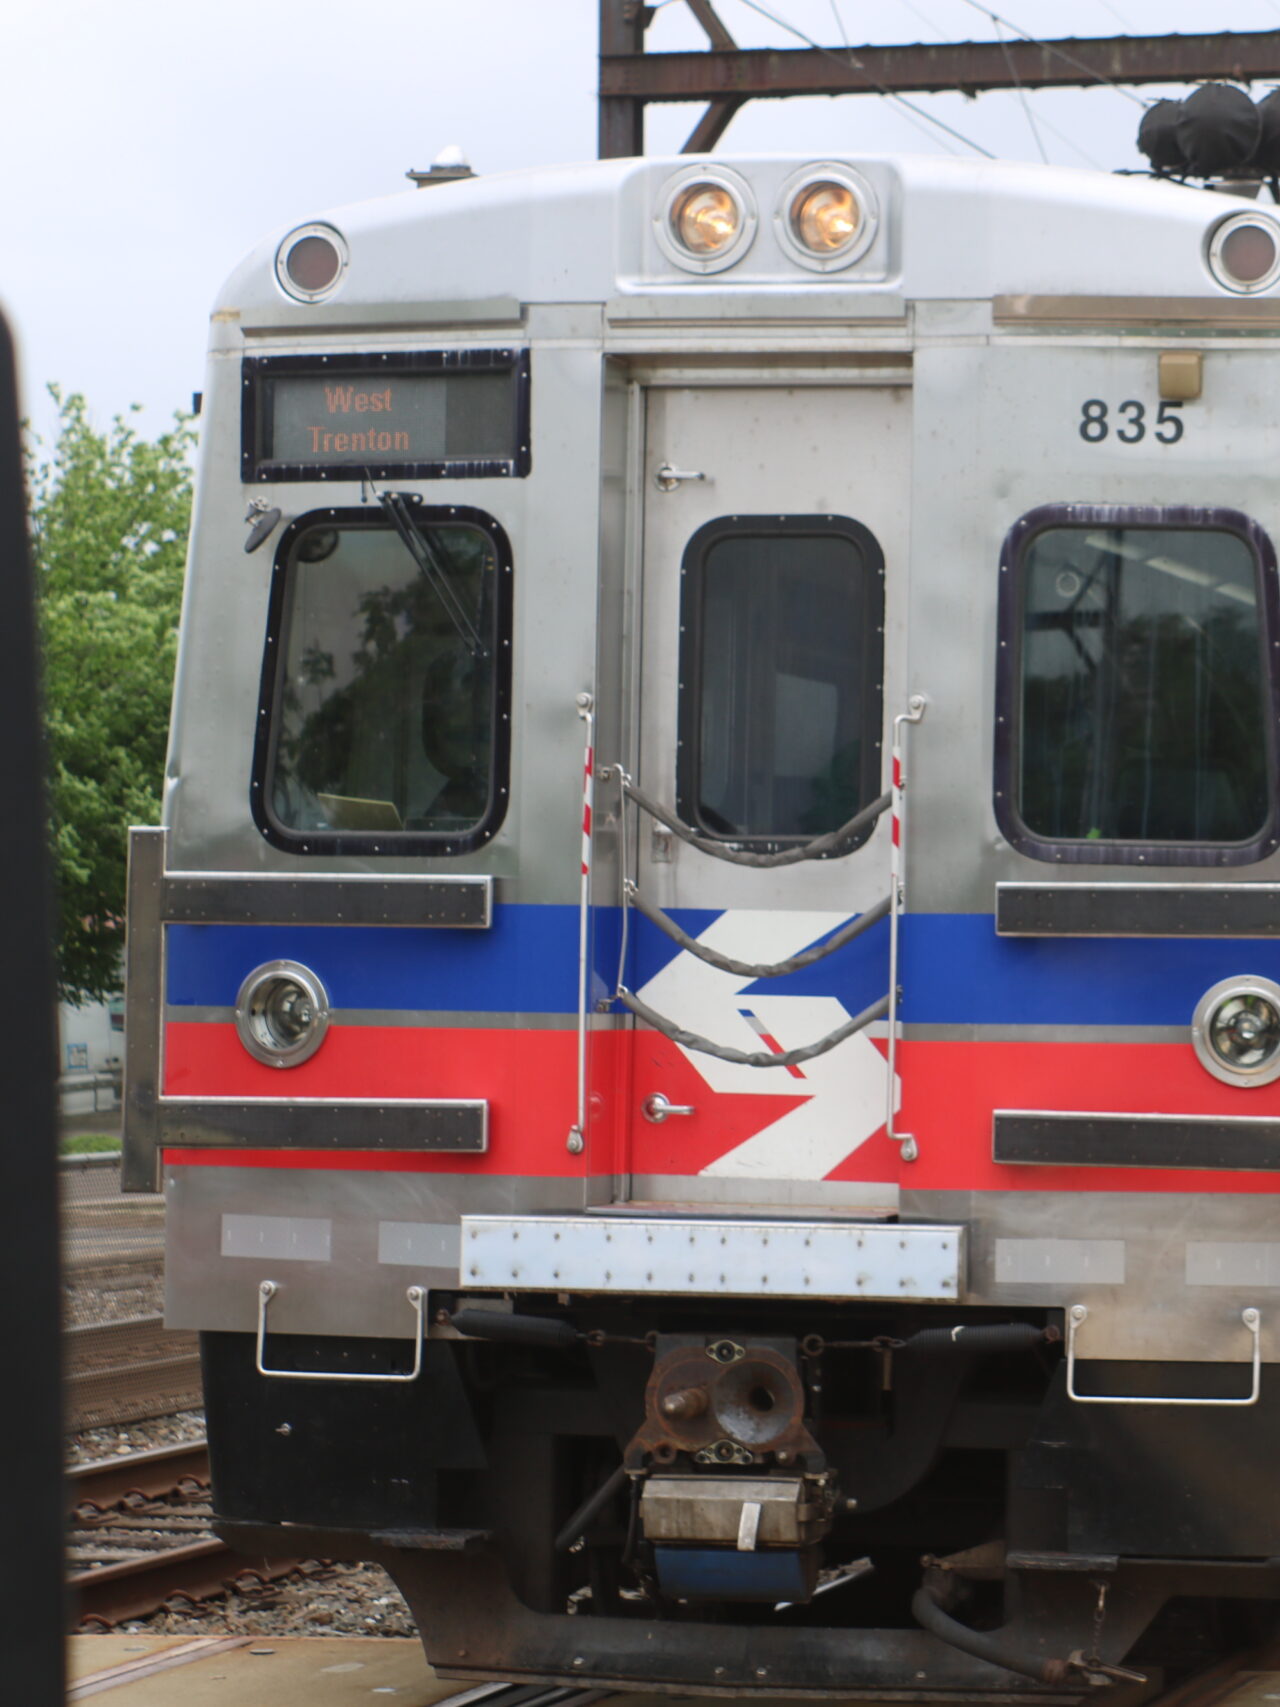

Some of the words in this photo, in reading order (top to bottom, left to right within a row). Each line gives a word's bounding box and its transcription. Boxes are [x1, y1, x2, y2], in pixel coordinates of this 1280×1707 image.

[323, 385, 393, 413] West
[1079, 398, 1184, 444] 835
[306, 425, 410, 452] Trenton
